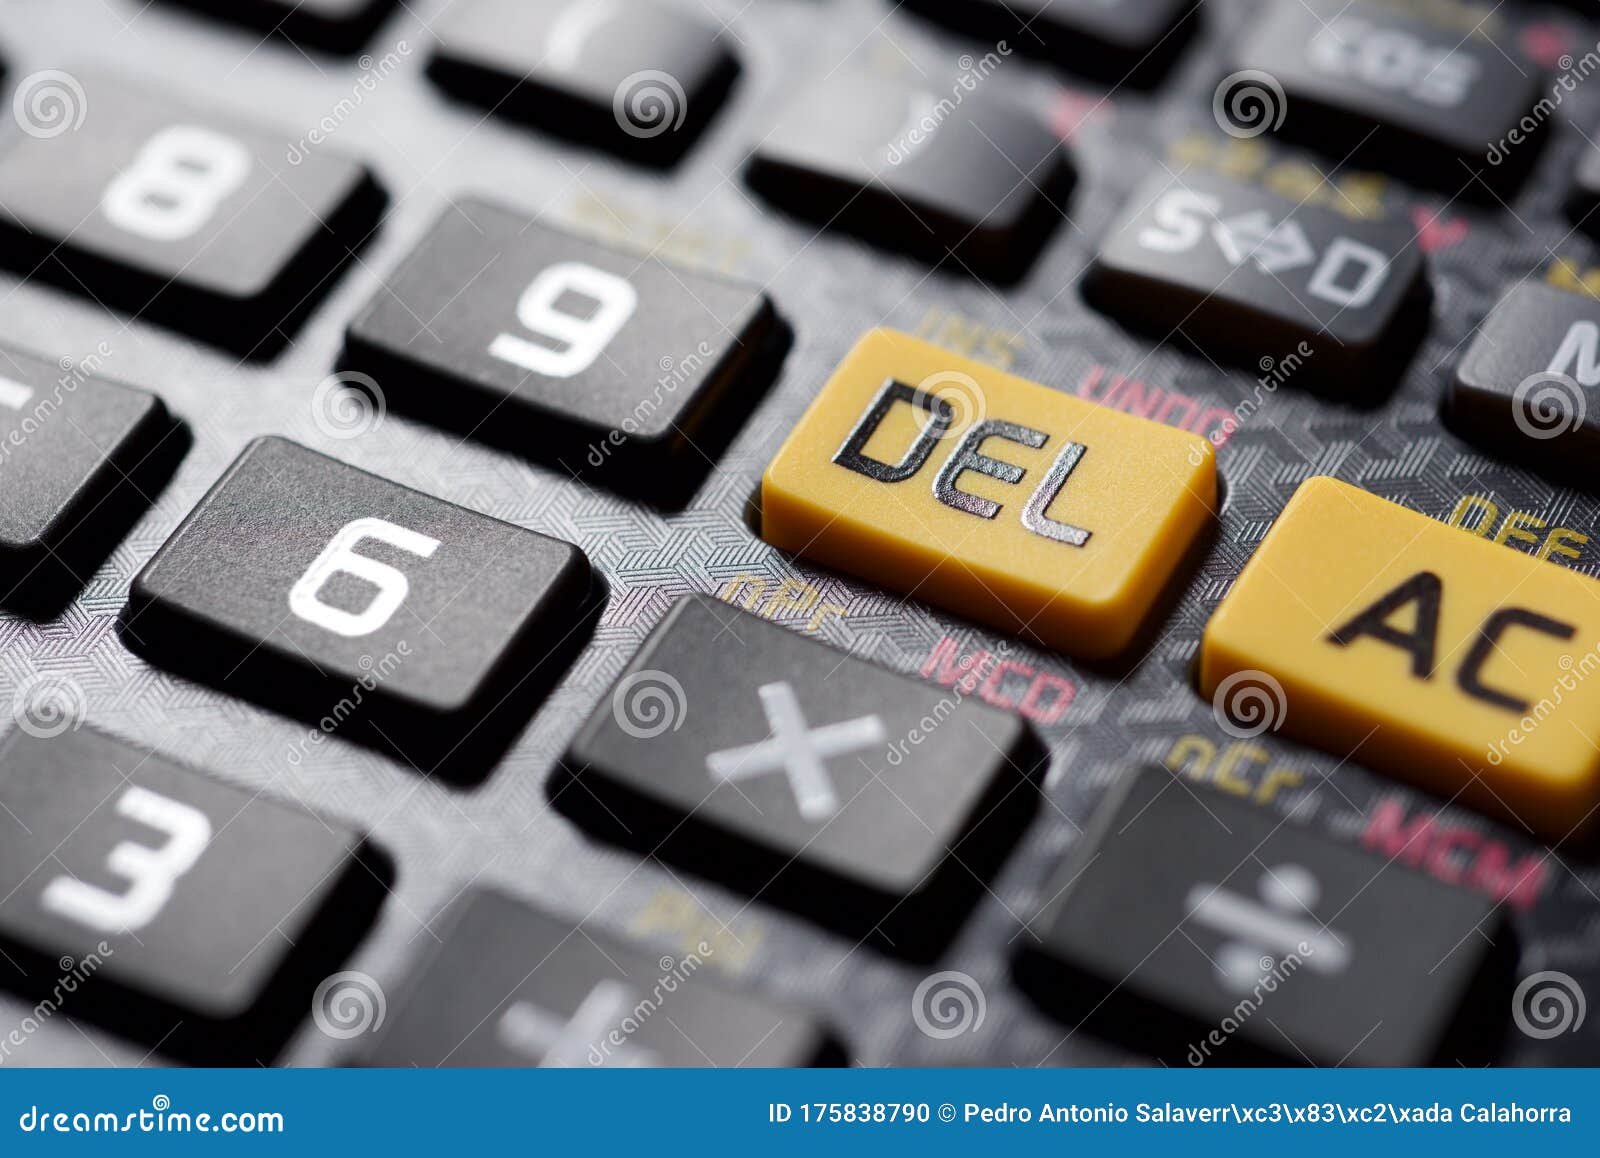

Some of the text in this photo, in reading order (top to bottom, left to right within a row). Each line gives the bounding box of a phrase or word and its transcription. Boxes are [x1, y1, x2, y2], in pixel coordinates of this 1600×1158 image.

[103, 123, 252, 241] 8
[487, 261, 638, 378] 9
[831, 377, 1092, 547] DEL
[288, 516, 442, 637] 6
[920, 635, 1076, 724] MCD
[1324, 570, 1577, 715] AC
[42, 786, 212, 934] 3
